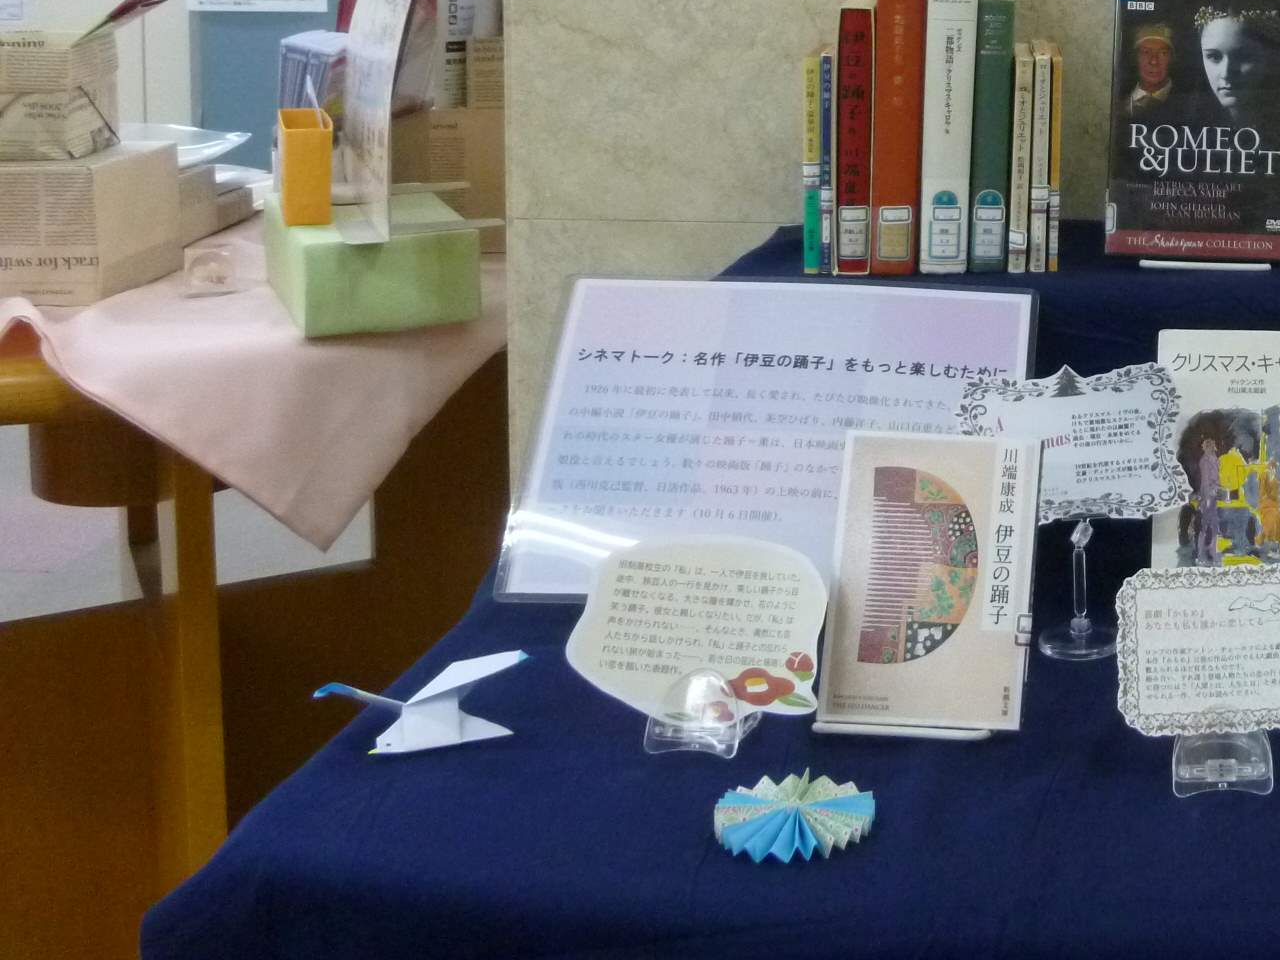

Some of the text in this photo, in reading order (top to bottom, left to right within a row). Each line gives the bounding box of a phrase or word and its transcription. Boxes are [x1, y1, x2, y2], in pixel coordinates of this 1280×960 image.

[1127, 1, 1155, 11] BBC
[1128, 123, 1260, 151] ROMEO
[1151, 202, 1177, 210] JOHN
[1127, 236, 1149, 246] THE
[1206, 241, 1273, 250] COLLECTION
[36, 256, 59, 270] for
[999, 448, 1019, 515] 川端康成
[988, 524, 1015, 625] 伊豆の踊子
